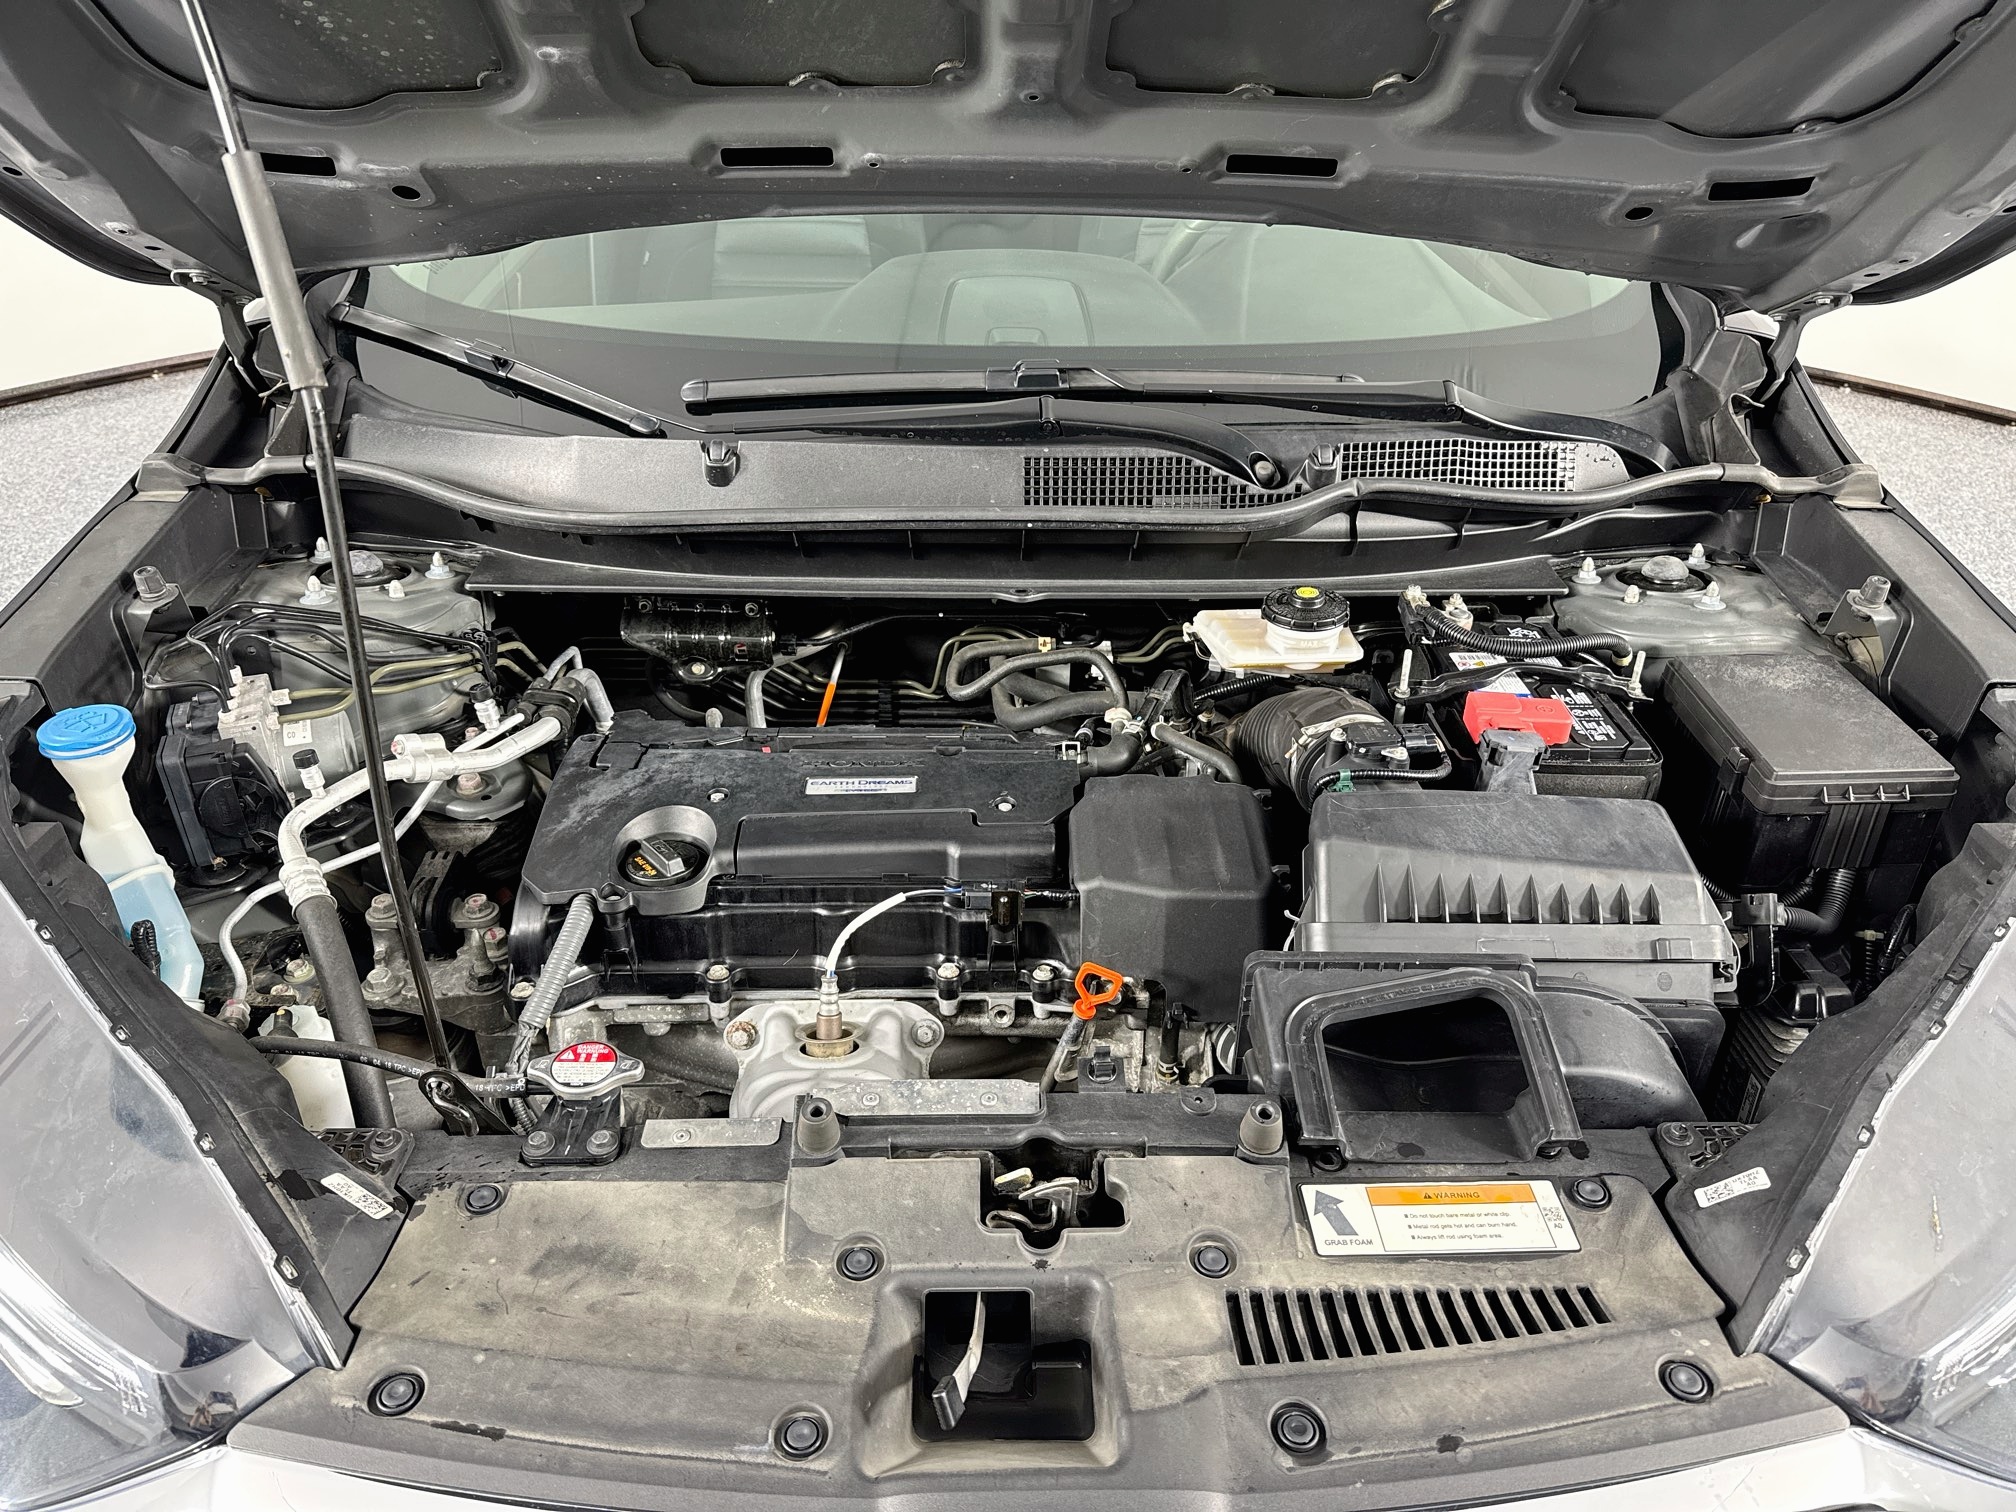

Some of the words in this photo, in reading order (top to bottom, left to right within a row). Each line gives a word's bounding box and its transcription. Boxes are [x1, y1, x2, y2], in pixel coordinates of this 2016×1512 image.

[1300, 640, 1320, 648] MAX
[384, 1061, 392, 1069] 18
[1434, 1191, 1480, 1199] WARNING
